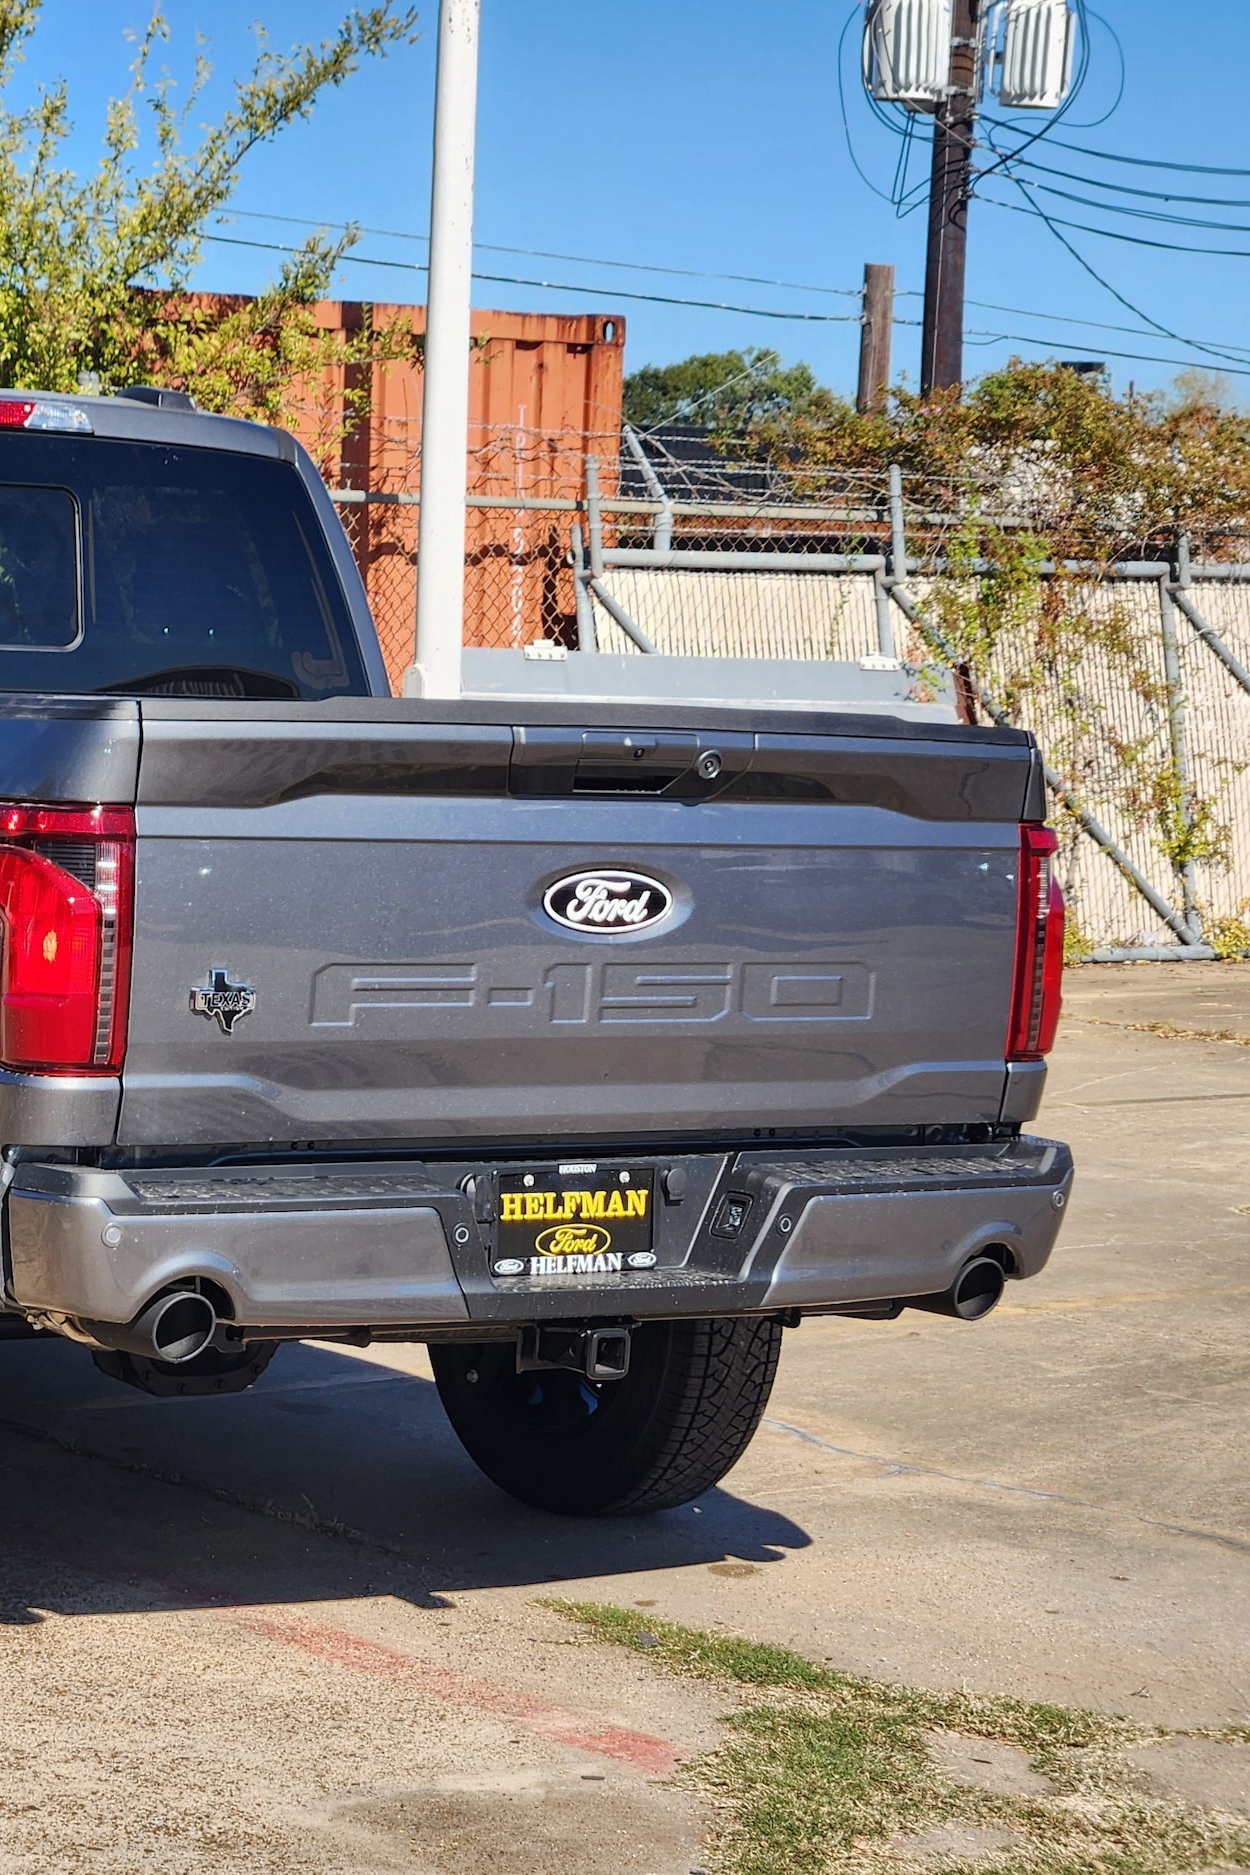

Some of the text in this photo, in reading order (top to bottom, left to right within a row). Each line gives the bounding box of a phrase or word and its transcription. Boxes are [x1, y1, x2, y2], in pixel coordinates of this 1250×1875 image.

[566, 878, 652, 923] Ford
[201, 991, 251, 1008] TEXAS
[309, 962, 877, 1027] F-150
[500, 1189, 649, 1221] HELFMAN
[550, 1226, 599, 1255] Ford
[529, 1252, 624, 1275] HELFMAN
